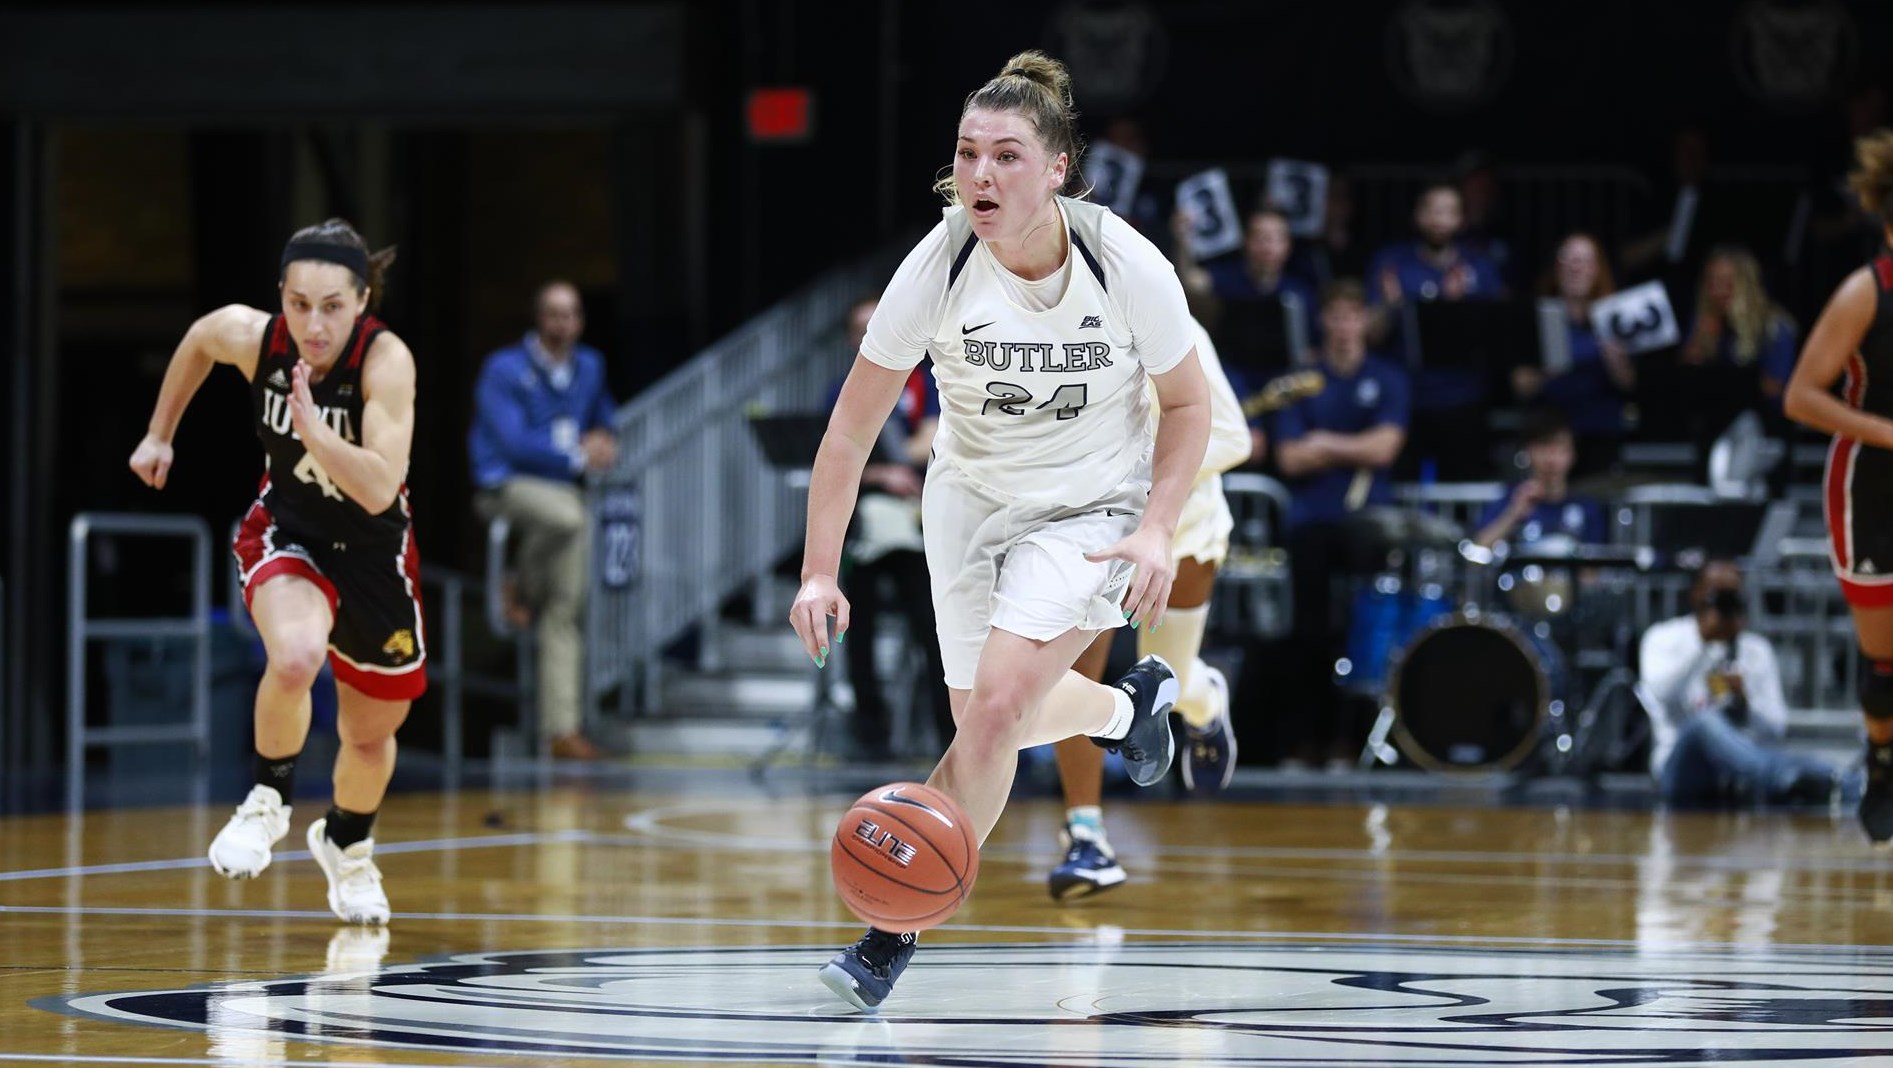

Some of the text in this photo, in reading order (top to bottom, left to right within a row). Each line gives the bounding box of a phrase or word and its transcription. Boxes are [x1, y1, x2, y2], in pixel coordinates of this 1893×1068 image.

[1194, 187, 1224, 238] 3
[1078, 320, 1103, 329] EAS
[1609, 302, 1662, 340] 3
[963, 339, 1114, 373] BUTLER
[981, 381, 1088, 421] 24
[292, 450, 344, 502] 4
[855, 818, 917, 866] ELITE
